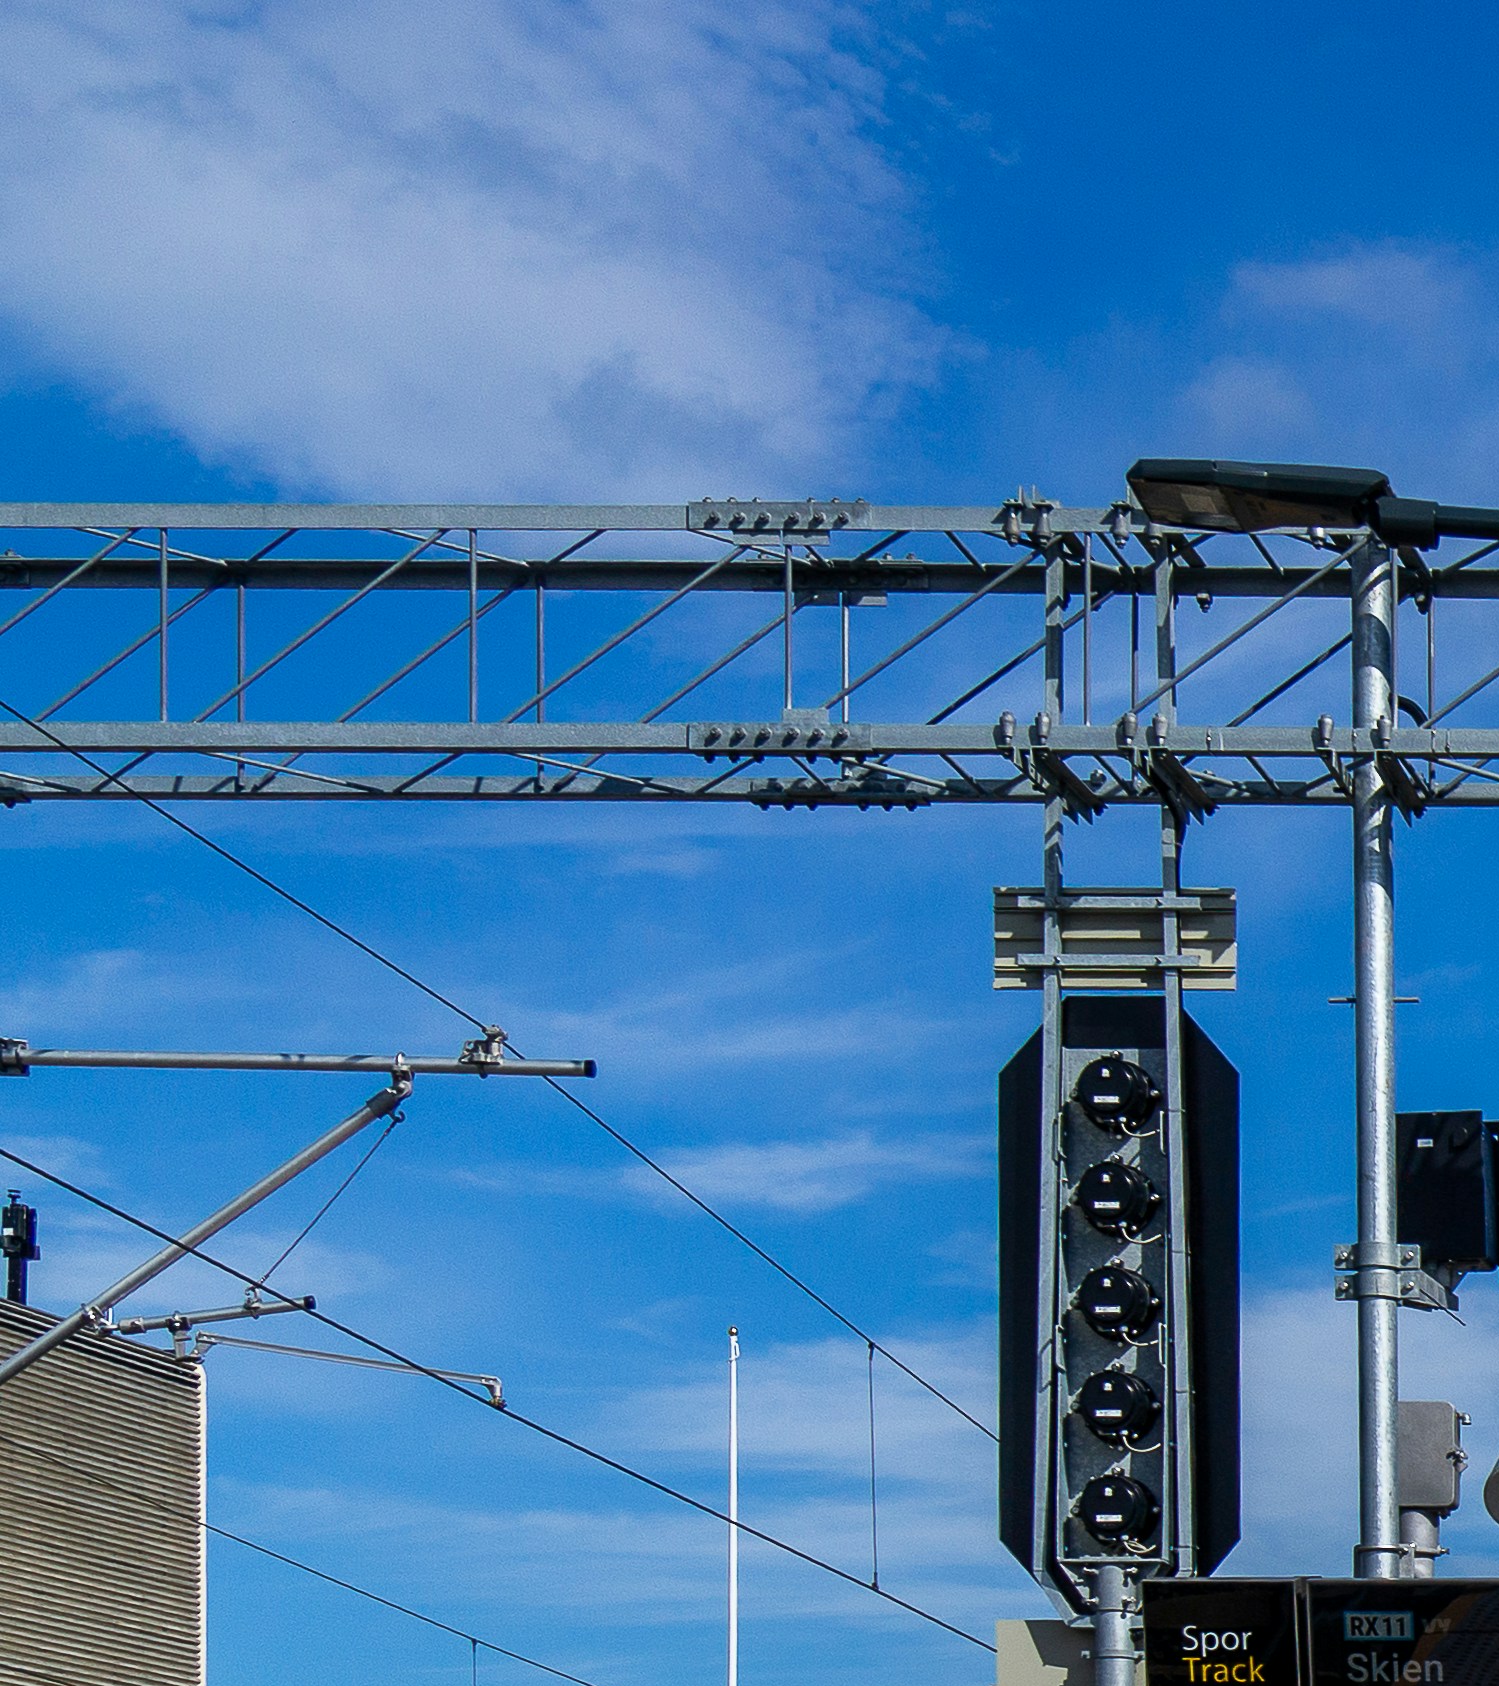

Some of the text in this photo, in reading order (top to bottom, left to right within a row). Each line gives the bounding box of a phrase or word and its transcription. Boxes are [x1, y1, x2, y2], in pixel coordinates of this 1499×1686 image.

[1182, 1625, 1253, 1658] Spor
[1182, 1656, 1265, 1683] Track
[1346, 1651, 1445, 1683] Skien
